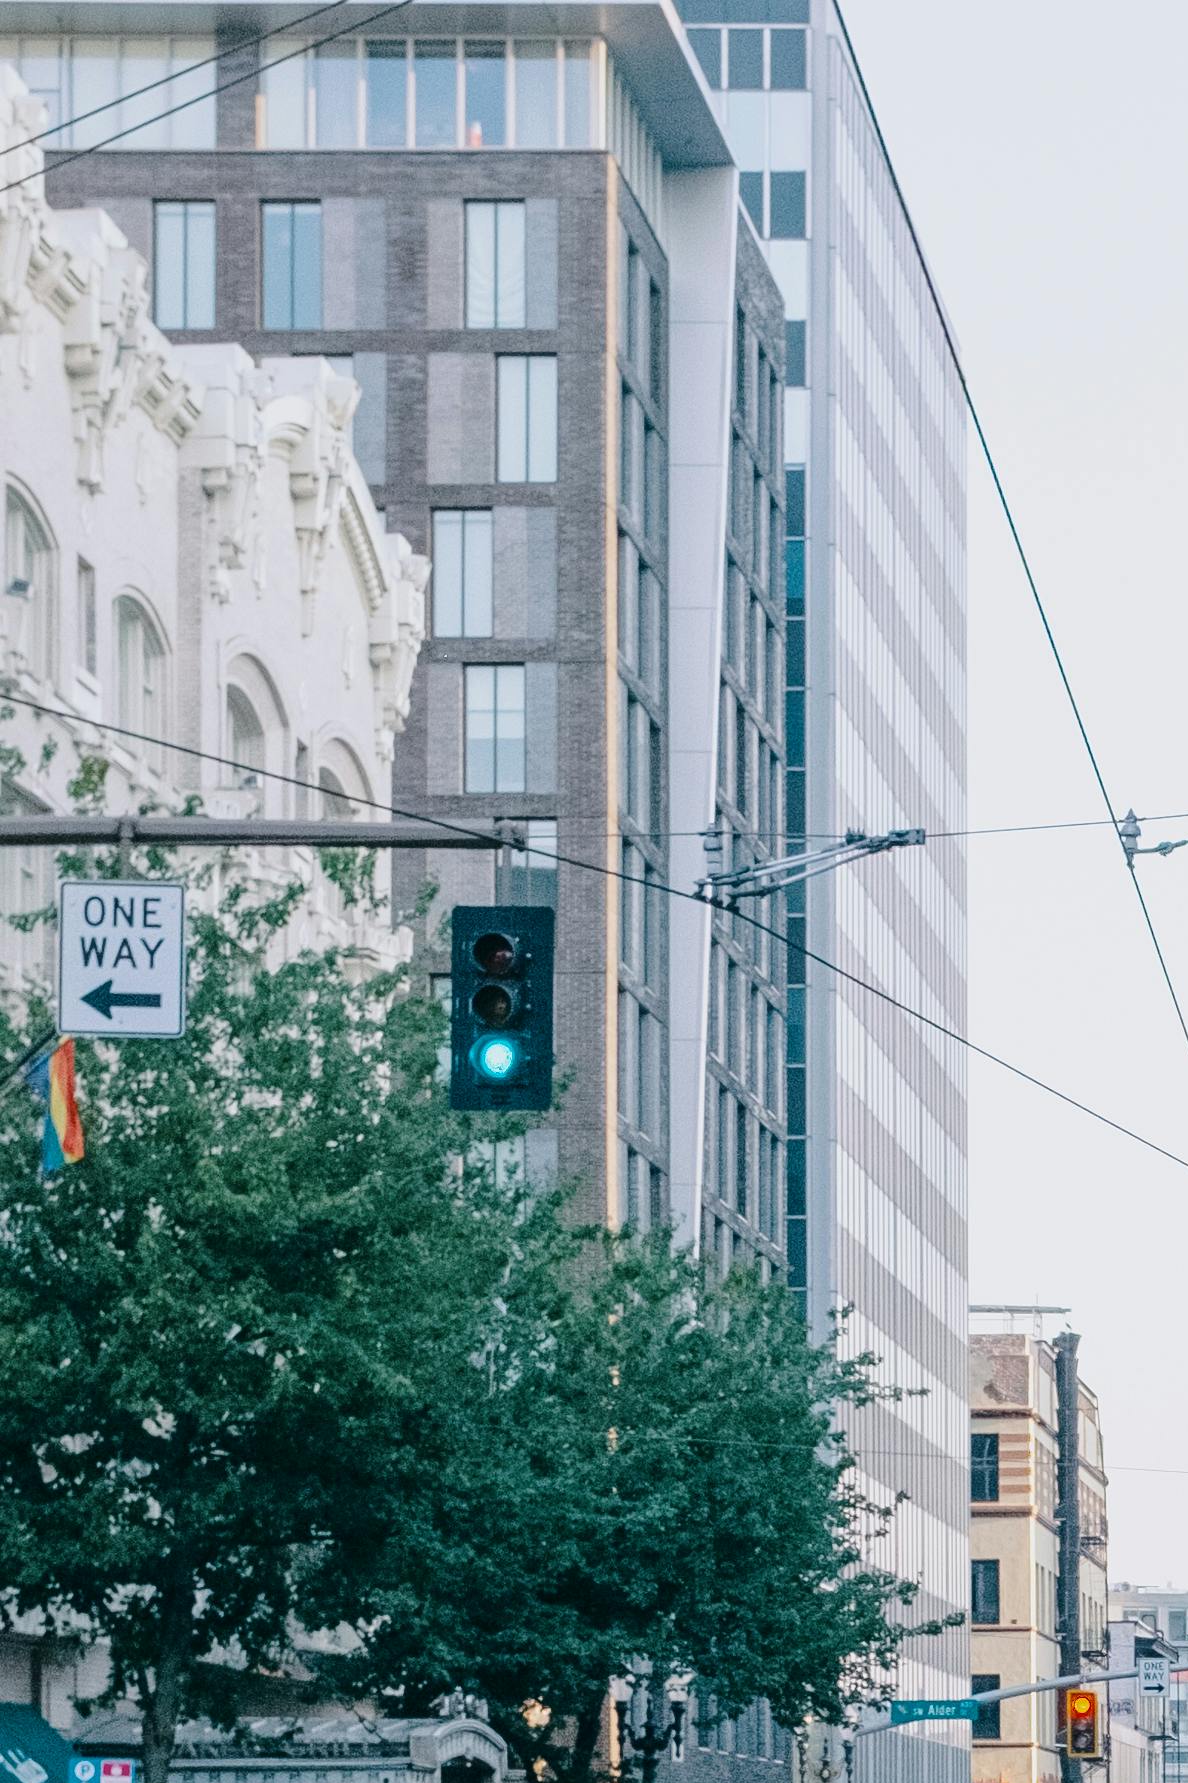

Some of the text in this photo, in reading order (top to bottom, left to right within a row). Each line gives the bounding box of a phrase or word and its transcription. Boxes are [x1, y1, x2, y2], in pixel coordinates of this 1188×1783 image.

[84, 896, 162, 928] ONE
[80, 936, 165, 969] WAY
[1144, 1661, 1165, 1671] ONE
[1144, 1671, 1165, 1681] WAY
[927, 1704, 956, 1716] Alder
